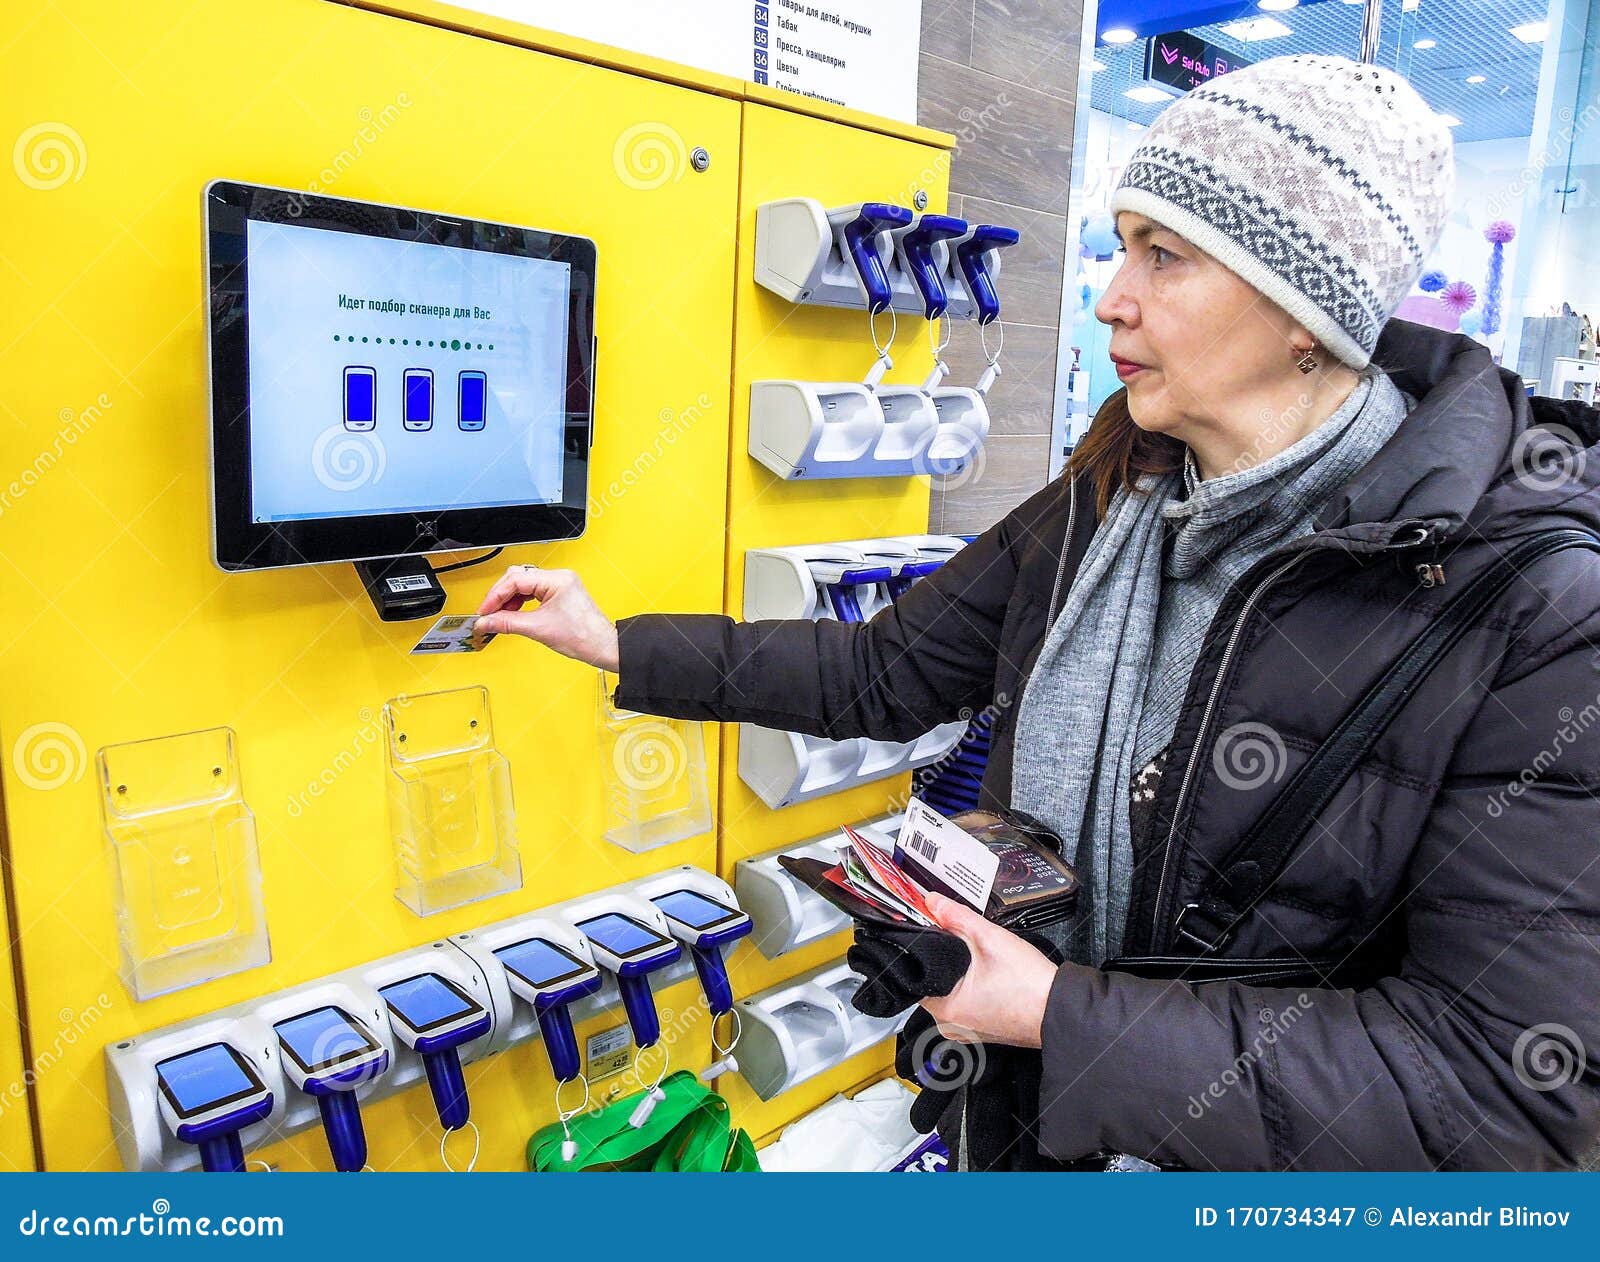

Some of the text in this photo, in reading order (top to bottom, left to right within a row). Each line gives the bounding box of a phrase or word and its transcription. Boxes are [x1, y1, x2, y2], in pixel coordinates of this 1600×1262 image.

[755, 8, 798, 32] 34 Табак
[806, 7, 819, 18] для
[820, 12, 842, 27] детей,
[843, 20, 872, 36] игрушки
[755, 31, 846, 68] 35 Пресса, канцелярия
[755, 53, 799, 75] 36 Цветы
[338, 294, 491, 320] Идет подбор сканера для Вас
